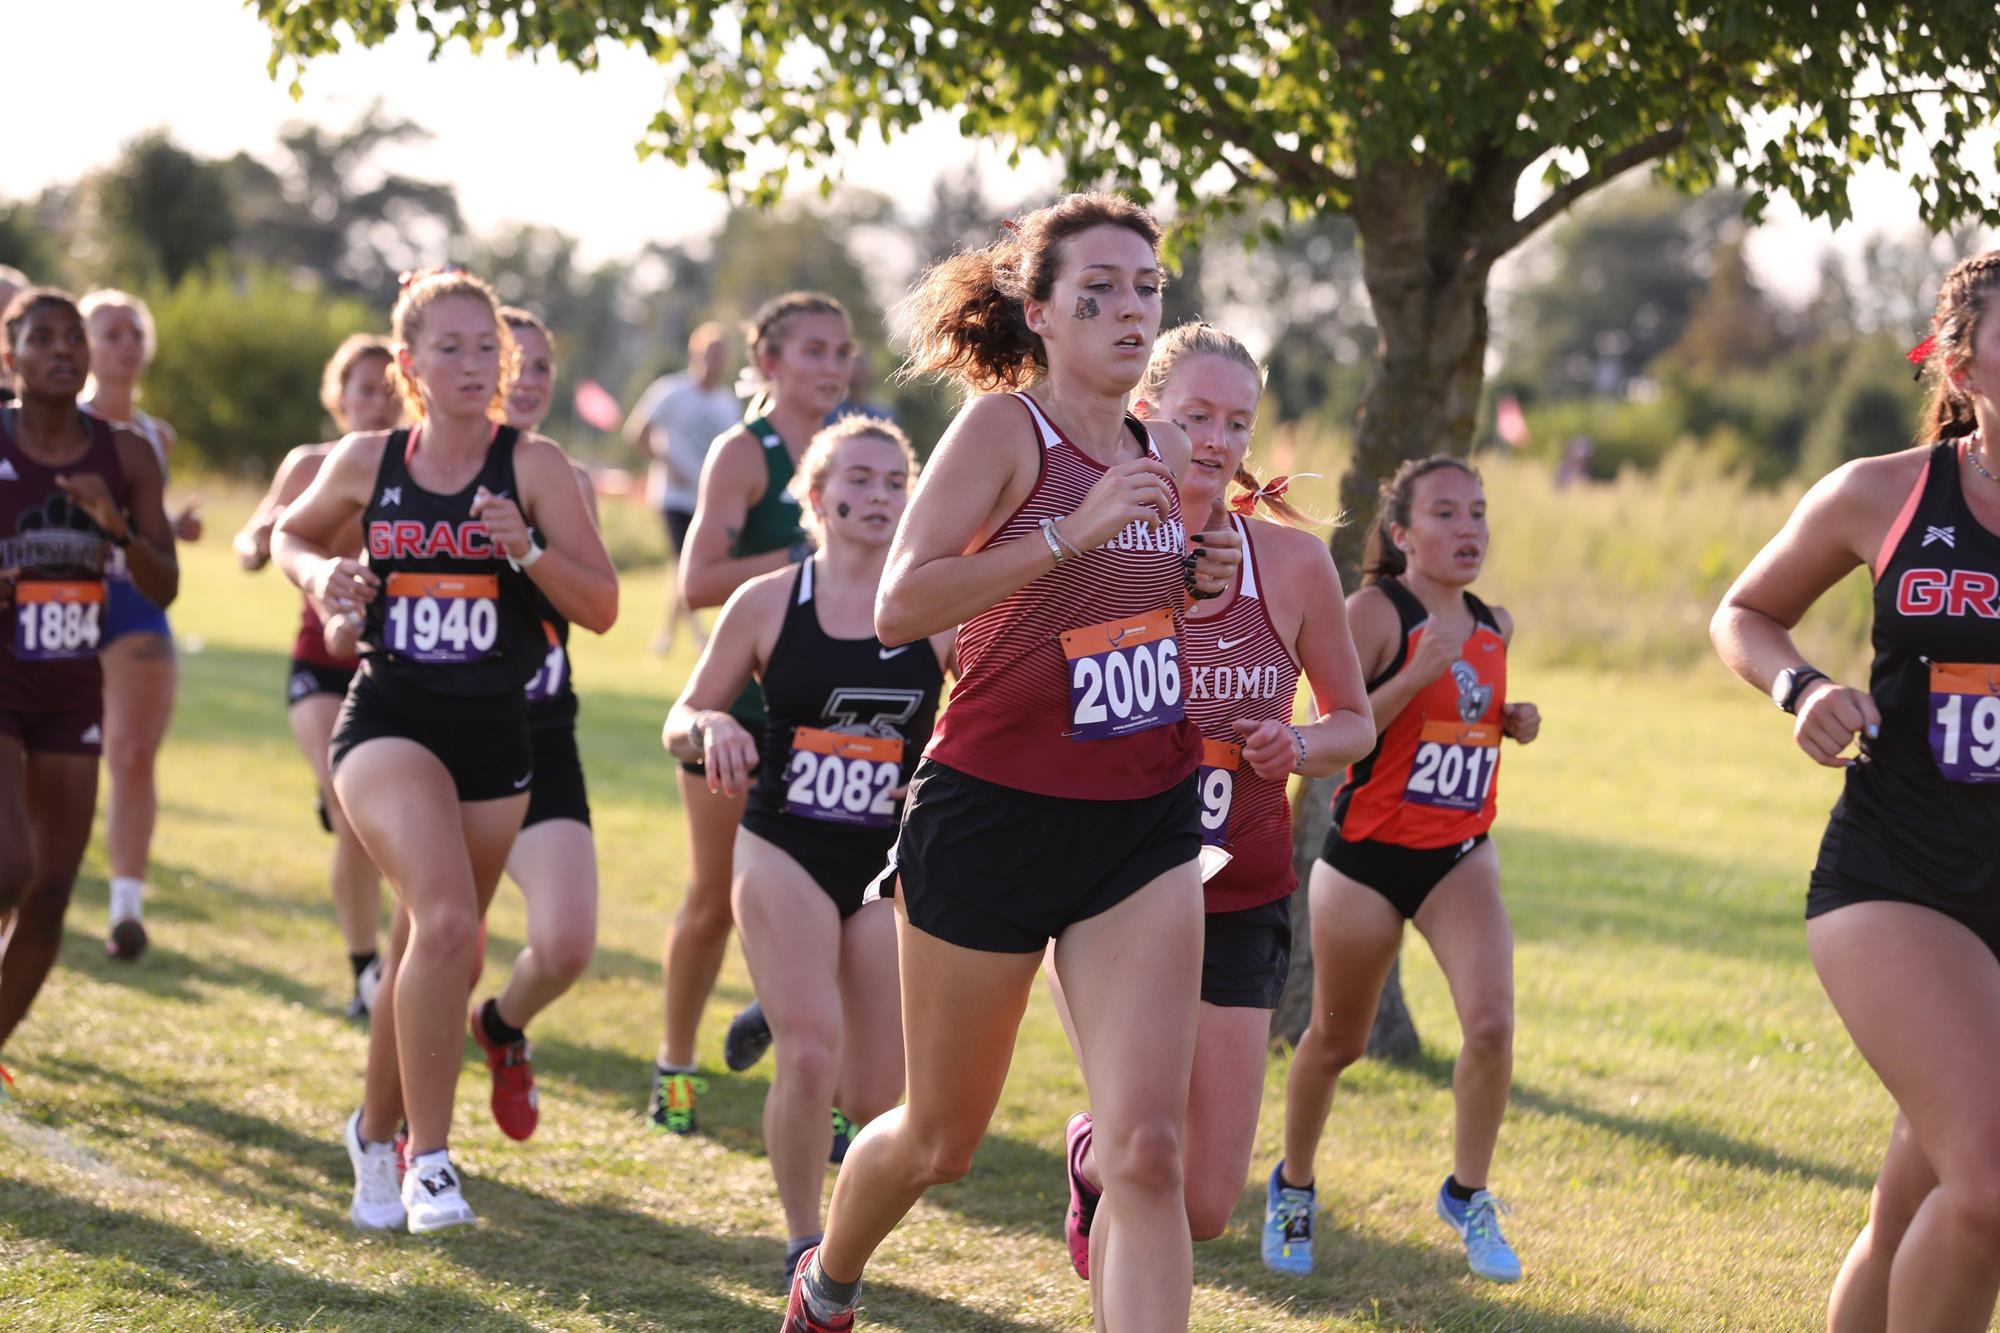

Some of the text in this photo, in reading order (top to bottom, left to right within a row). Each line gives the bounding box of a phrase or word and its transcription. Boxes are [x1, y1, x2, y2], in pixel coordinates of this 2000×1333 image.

[369, 521, 506, 559] GRAC
[1897, 568, 2000, 618] GR
[19, 601, 100, 650] 1884
[390, 596, 498, 651] 1940
[1073, 638, 1181, 725] 2006
[1189, 665, 1278, 699] KOMO
[1937, 695, 2000, 767] 19
[786, 750, 901, 815] 2082
[1407, 742, 1499, 799] 2017
[1197, 769, 1233, 830] 9
